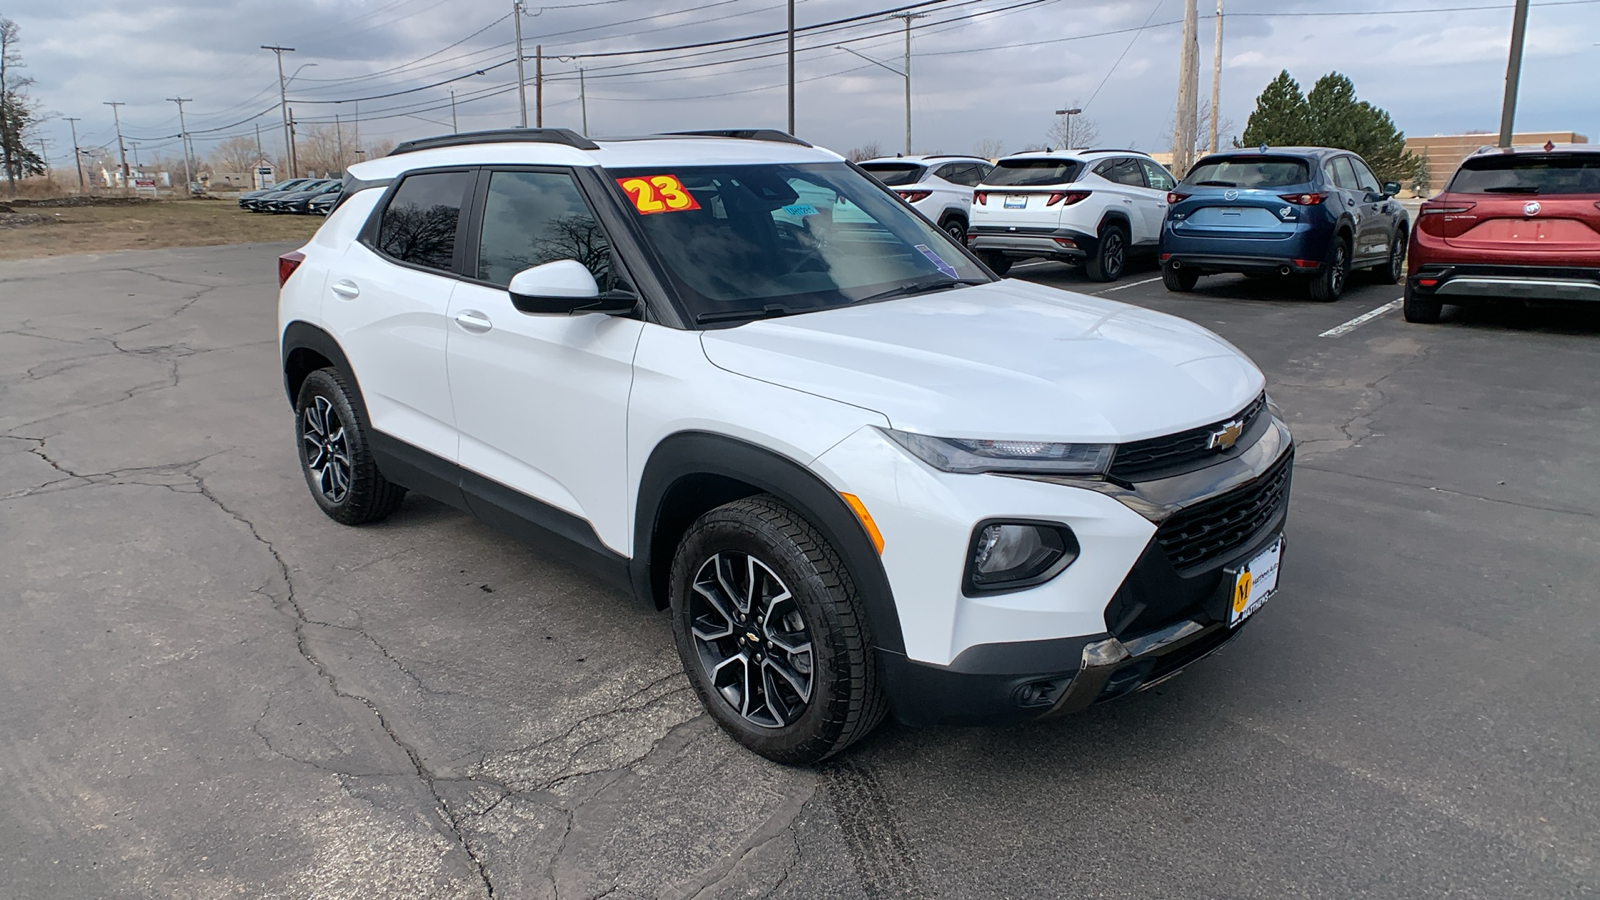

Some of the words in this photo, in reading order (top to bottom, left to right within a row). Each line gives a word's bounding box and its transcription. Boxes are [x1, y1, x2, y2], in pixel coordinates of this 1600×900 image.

[622, 175, 692, 213] 23
[1236, 579, 1250, 606] M
[1241, 591, 1270, 621] MATTHEWS
